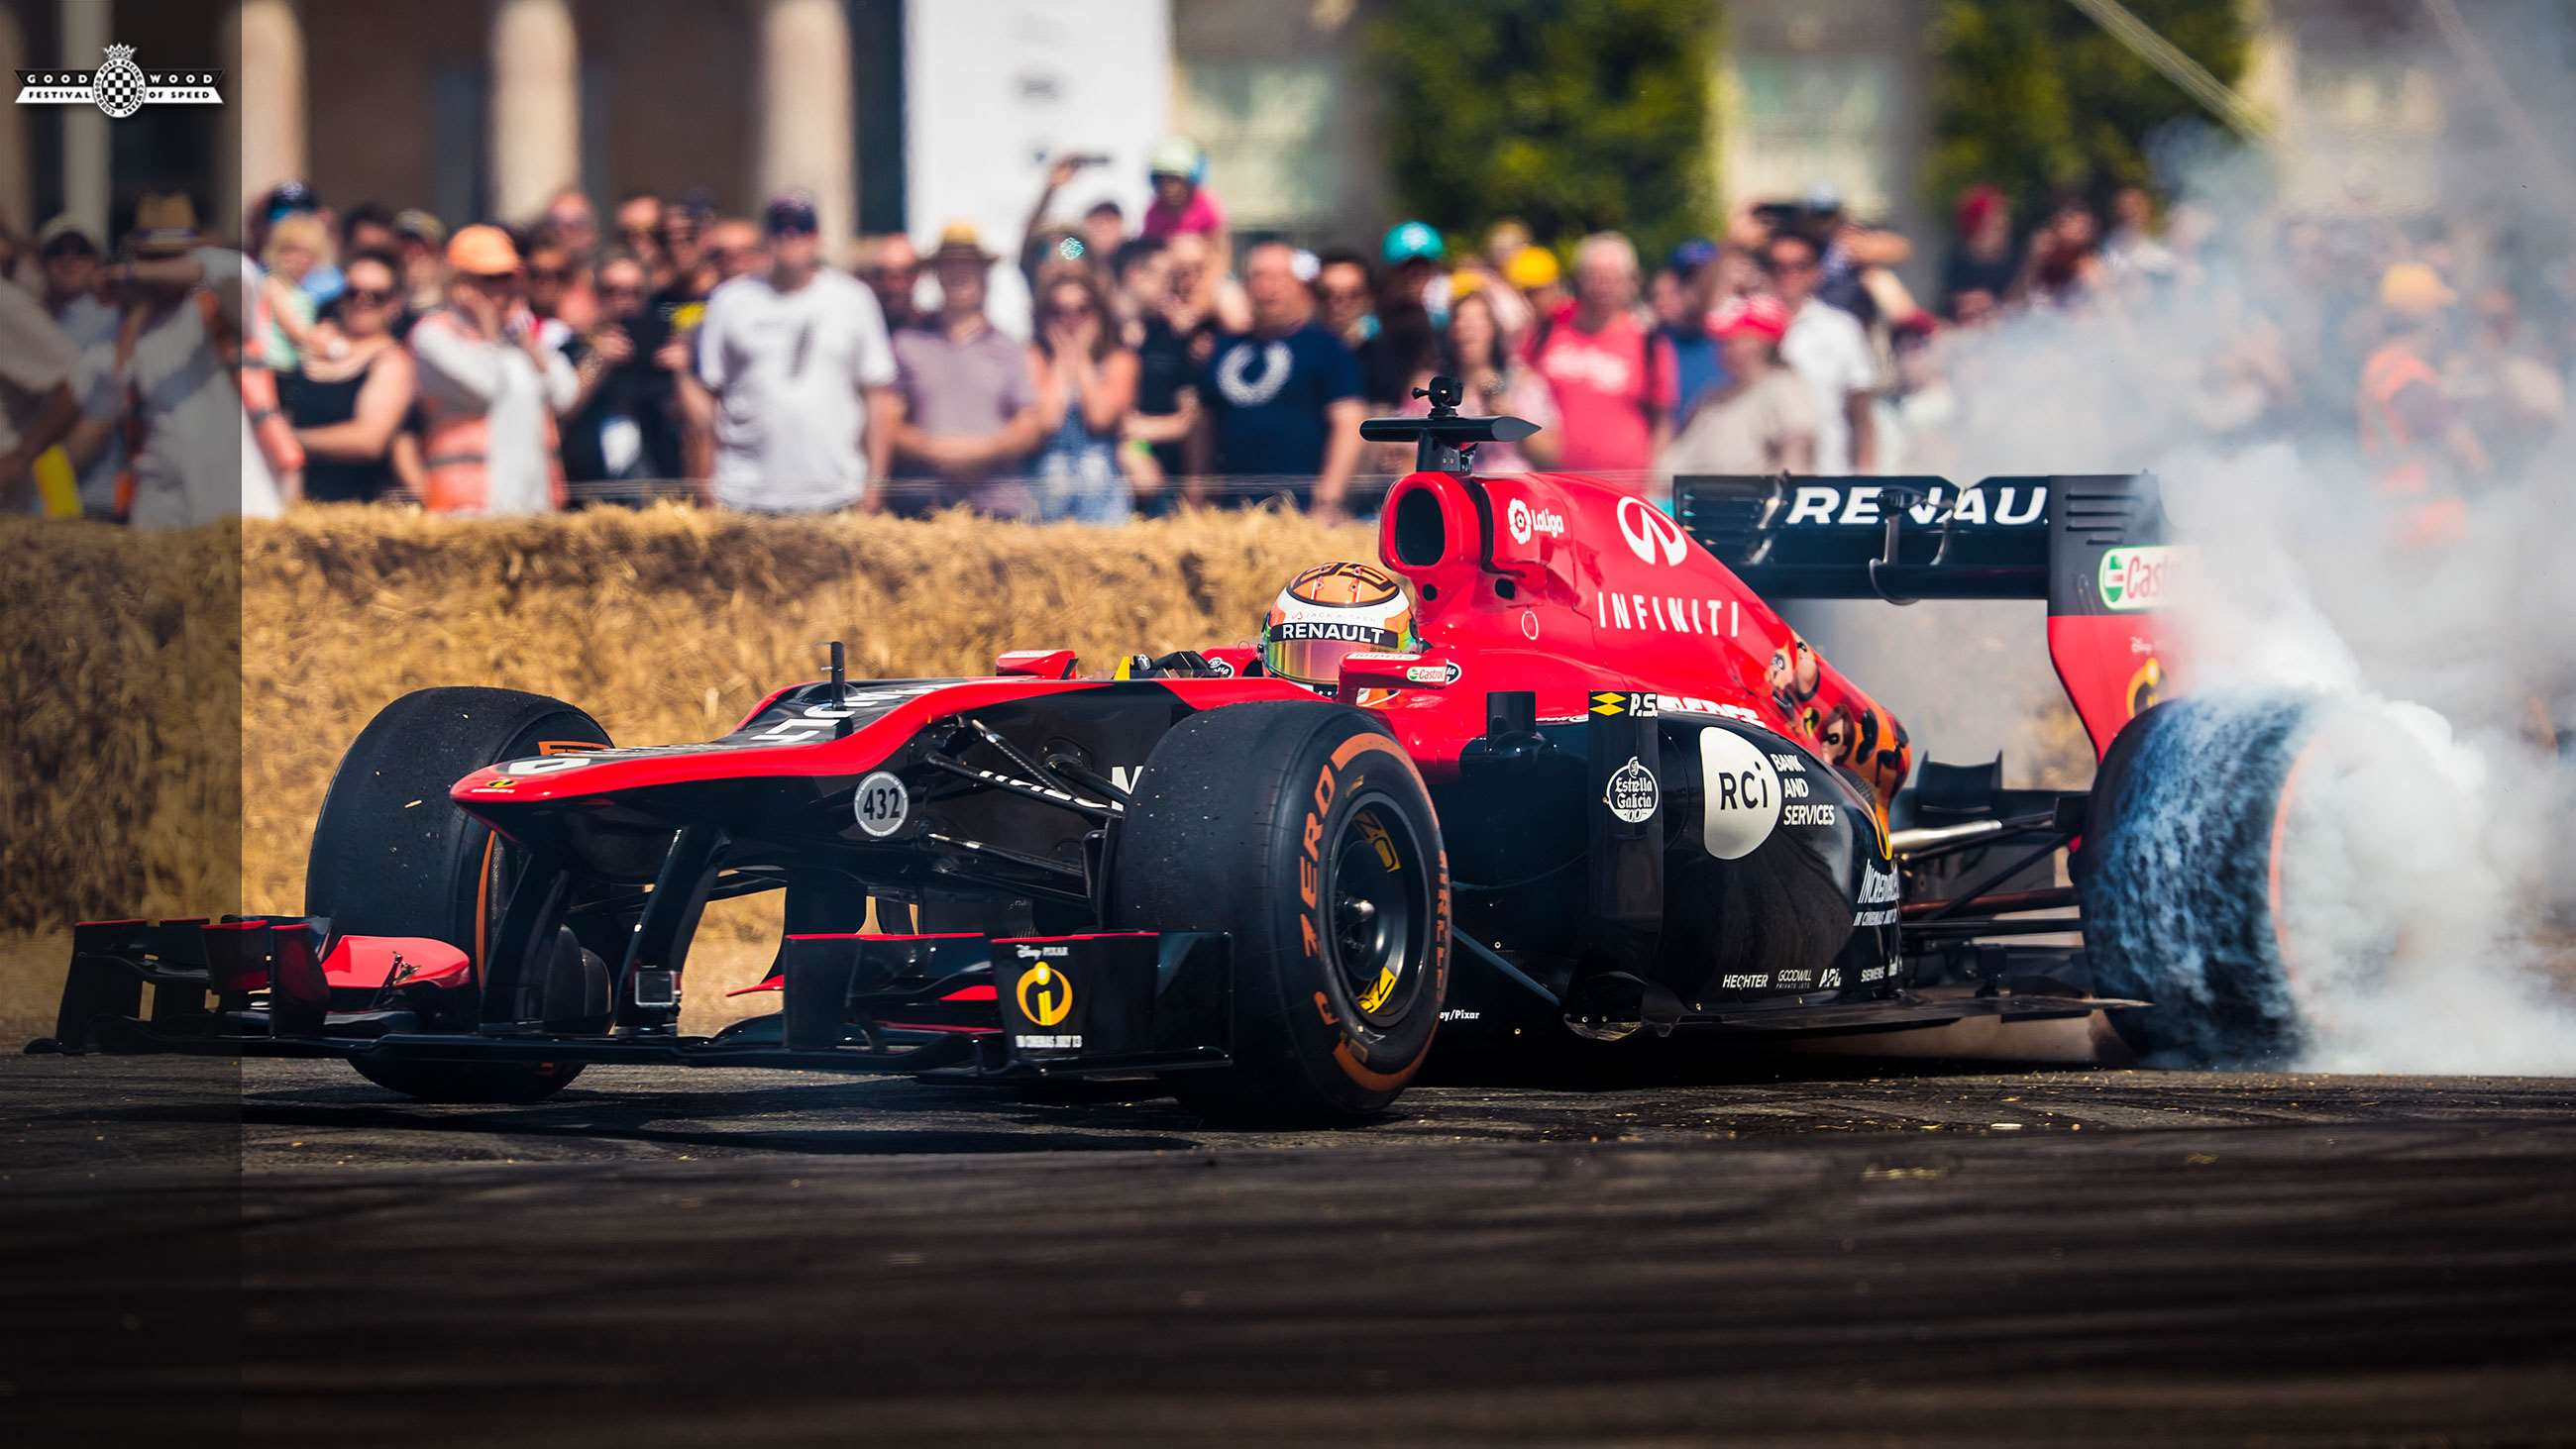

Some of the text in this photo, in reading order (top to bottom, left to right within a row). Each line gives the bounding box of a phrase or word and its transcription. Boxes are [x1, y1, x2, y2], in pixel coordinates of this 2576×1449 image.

[1785, 486, 2048, 525] RENAU
[1531, 507, 1564, 539] LaLiga
[1597, 591, 1739, 638] INFINITI
[1282, 623, 1384, 644] RENAULT
[1770, 754, 1806, 773] BANK
[1615, 776, 1653, 793] Estrella
[1718, 761, 1768, 810] RCi
[1783, 777, 1809, 798] AND
[863, 787, 901, 820] 432
[1617, 792, 1653, 809] Galicia
[1783, 804, 1835, 825] SERVICES
[1722, 974, 1769, 990] HECHTER
[1777, 969, 1812, 983] GOODWILL
[1439, 1008, 1480, 1022] ey/Pixar
